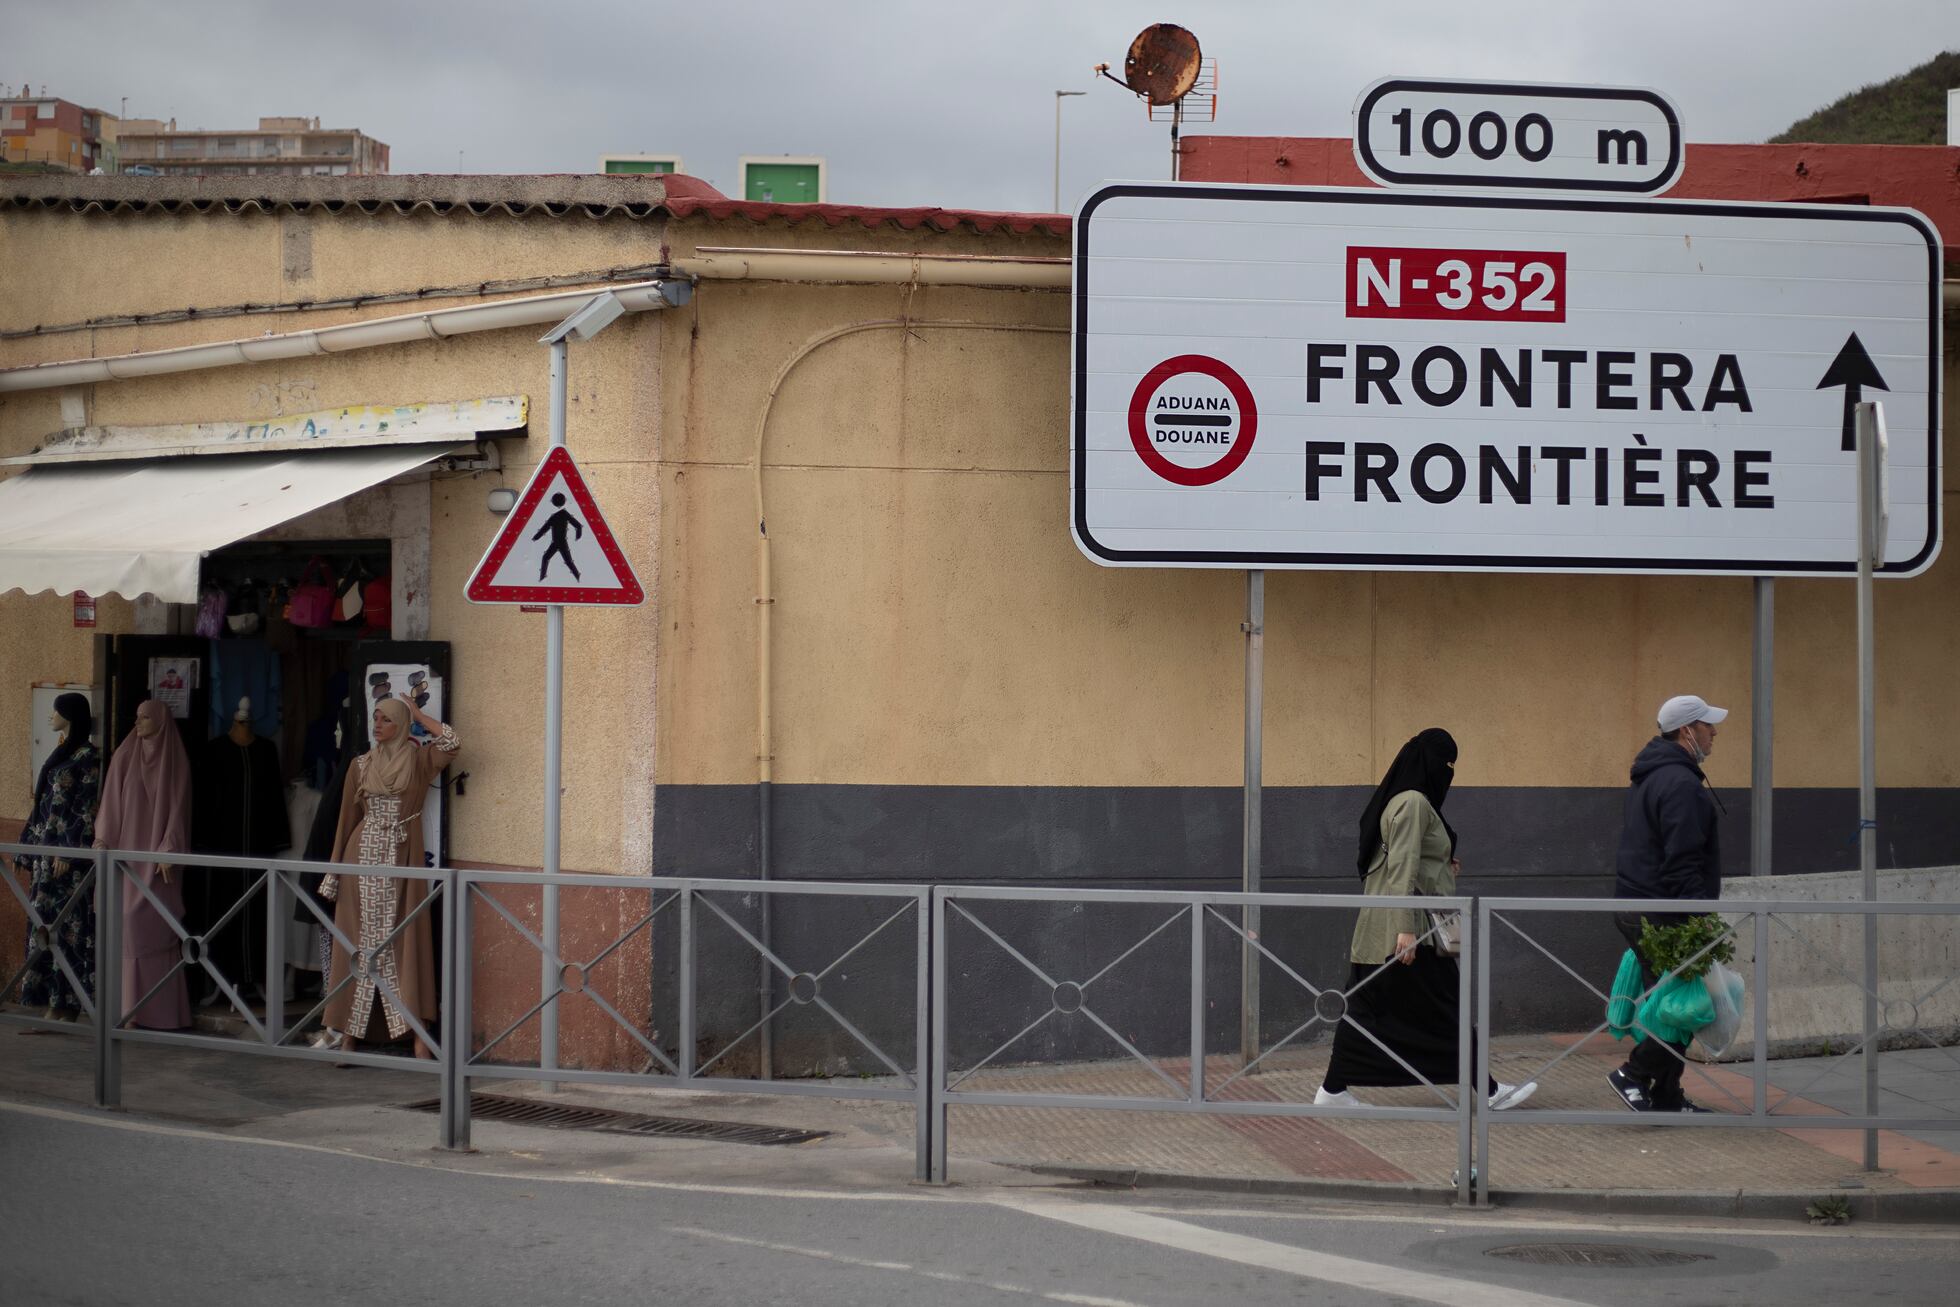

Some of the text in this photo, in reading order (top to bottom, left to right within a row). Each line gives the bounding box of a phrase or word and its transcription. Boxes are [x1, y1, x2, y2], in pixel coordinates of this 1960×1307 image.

[1391, 108, 1648, 166] 1000 m
[1356, 257, 1556, 312] N-352
[1156, 396, 1231, 411] ADUANA
[1306, 343, 1753, 413] FRONTERA
[1155, 429, 1230, 445] DOUANE
[1305, 433, 1775, 509] FRONTIÈRE
[1624, 1087, 1643, 1102] N
